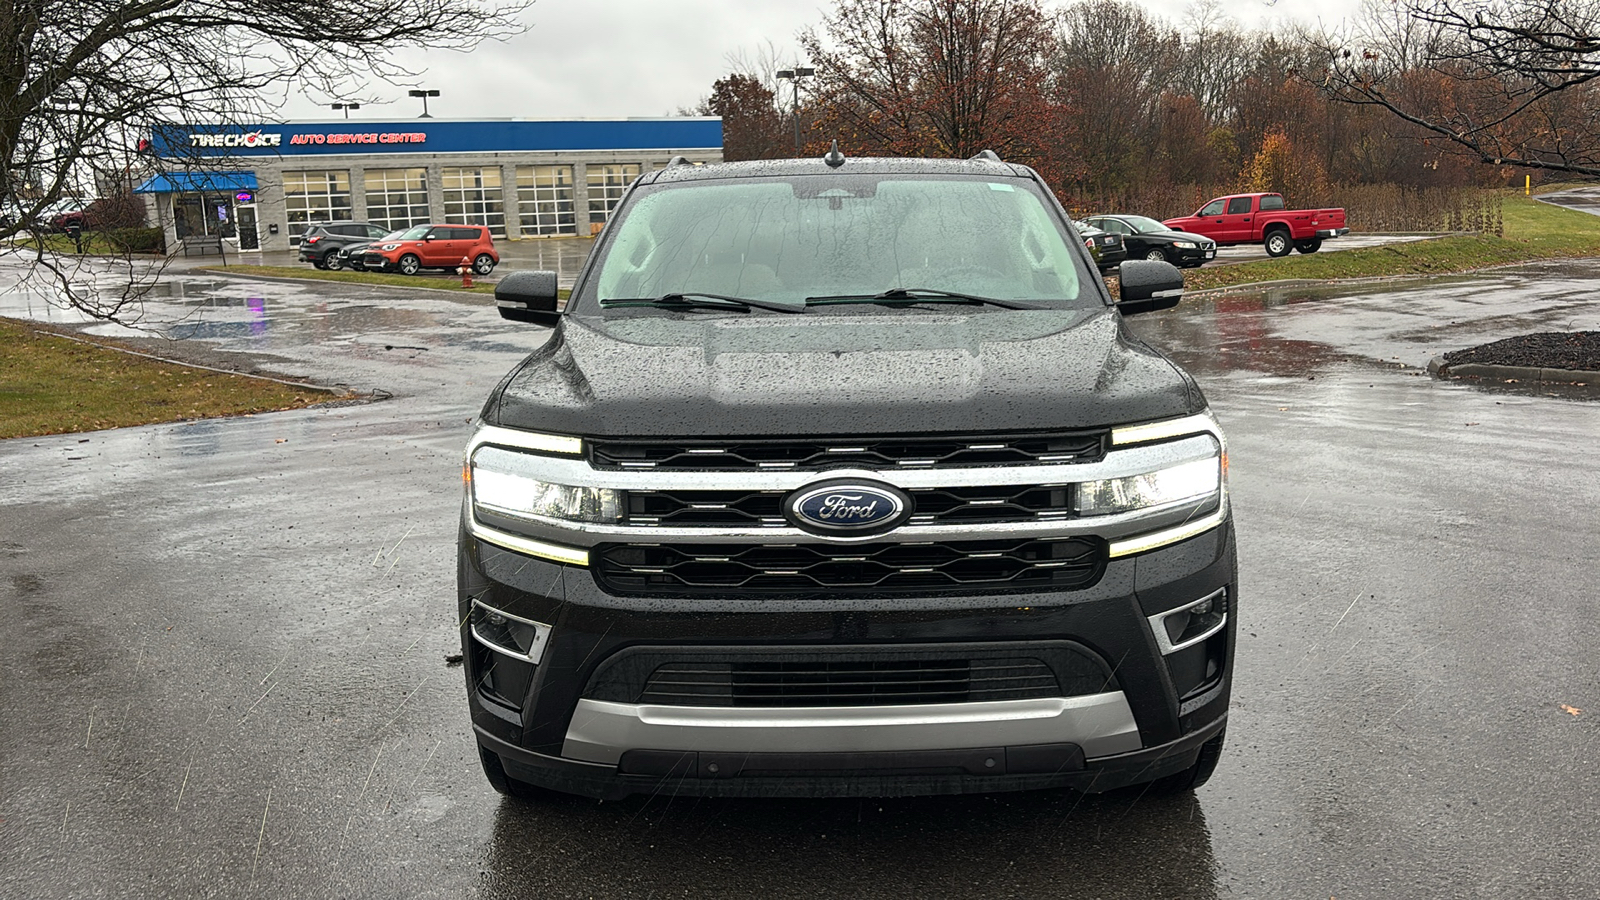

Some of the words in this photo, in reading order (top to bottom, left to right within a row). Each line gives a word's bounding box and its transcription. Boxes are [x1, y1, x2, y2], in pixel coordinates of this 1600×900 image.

[290, 134, 325, 144] AUTO
[326, 133, 378, 144] SERVICE
[379, 133, 426, 143] CENTER
[819, 494, 877, 519] Ford
